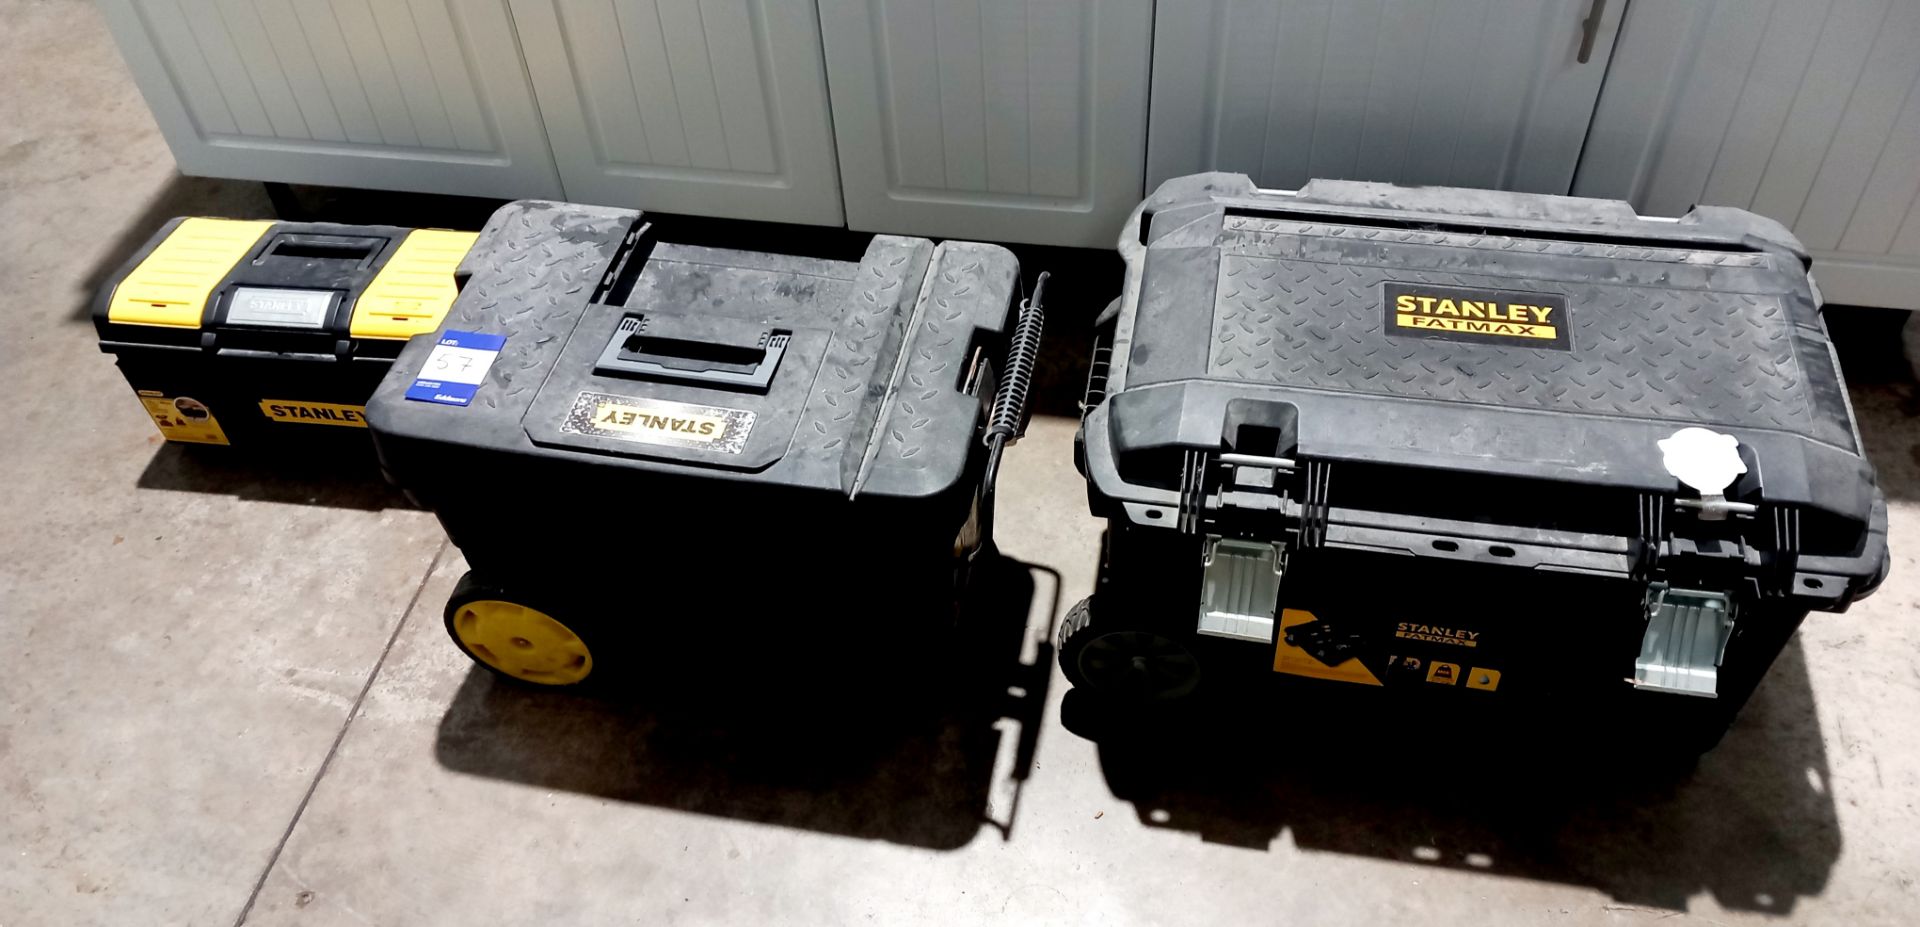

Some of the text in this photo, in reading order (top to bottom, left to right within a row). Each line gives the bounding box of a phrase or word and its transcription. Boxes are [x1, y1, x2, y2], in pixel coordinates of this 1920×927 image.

[1397, 295, 1553, 323] STANLEY
[1412, 317, 1536, 336] FATMAX
[437, 353, 474, 372] 57
[602, 410, 716, 435] STANLEY
[1398, 622, 1480, 640] STANLEY
